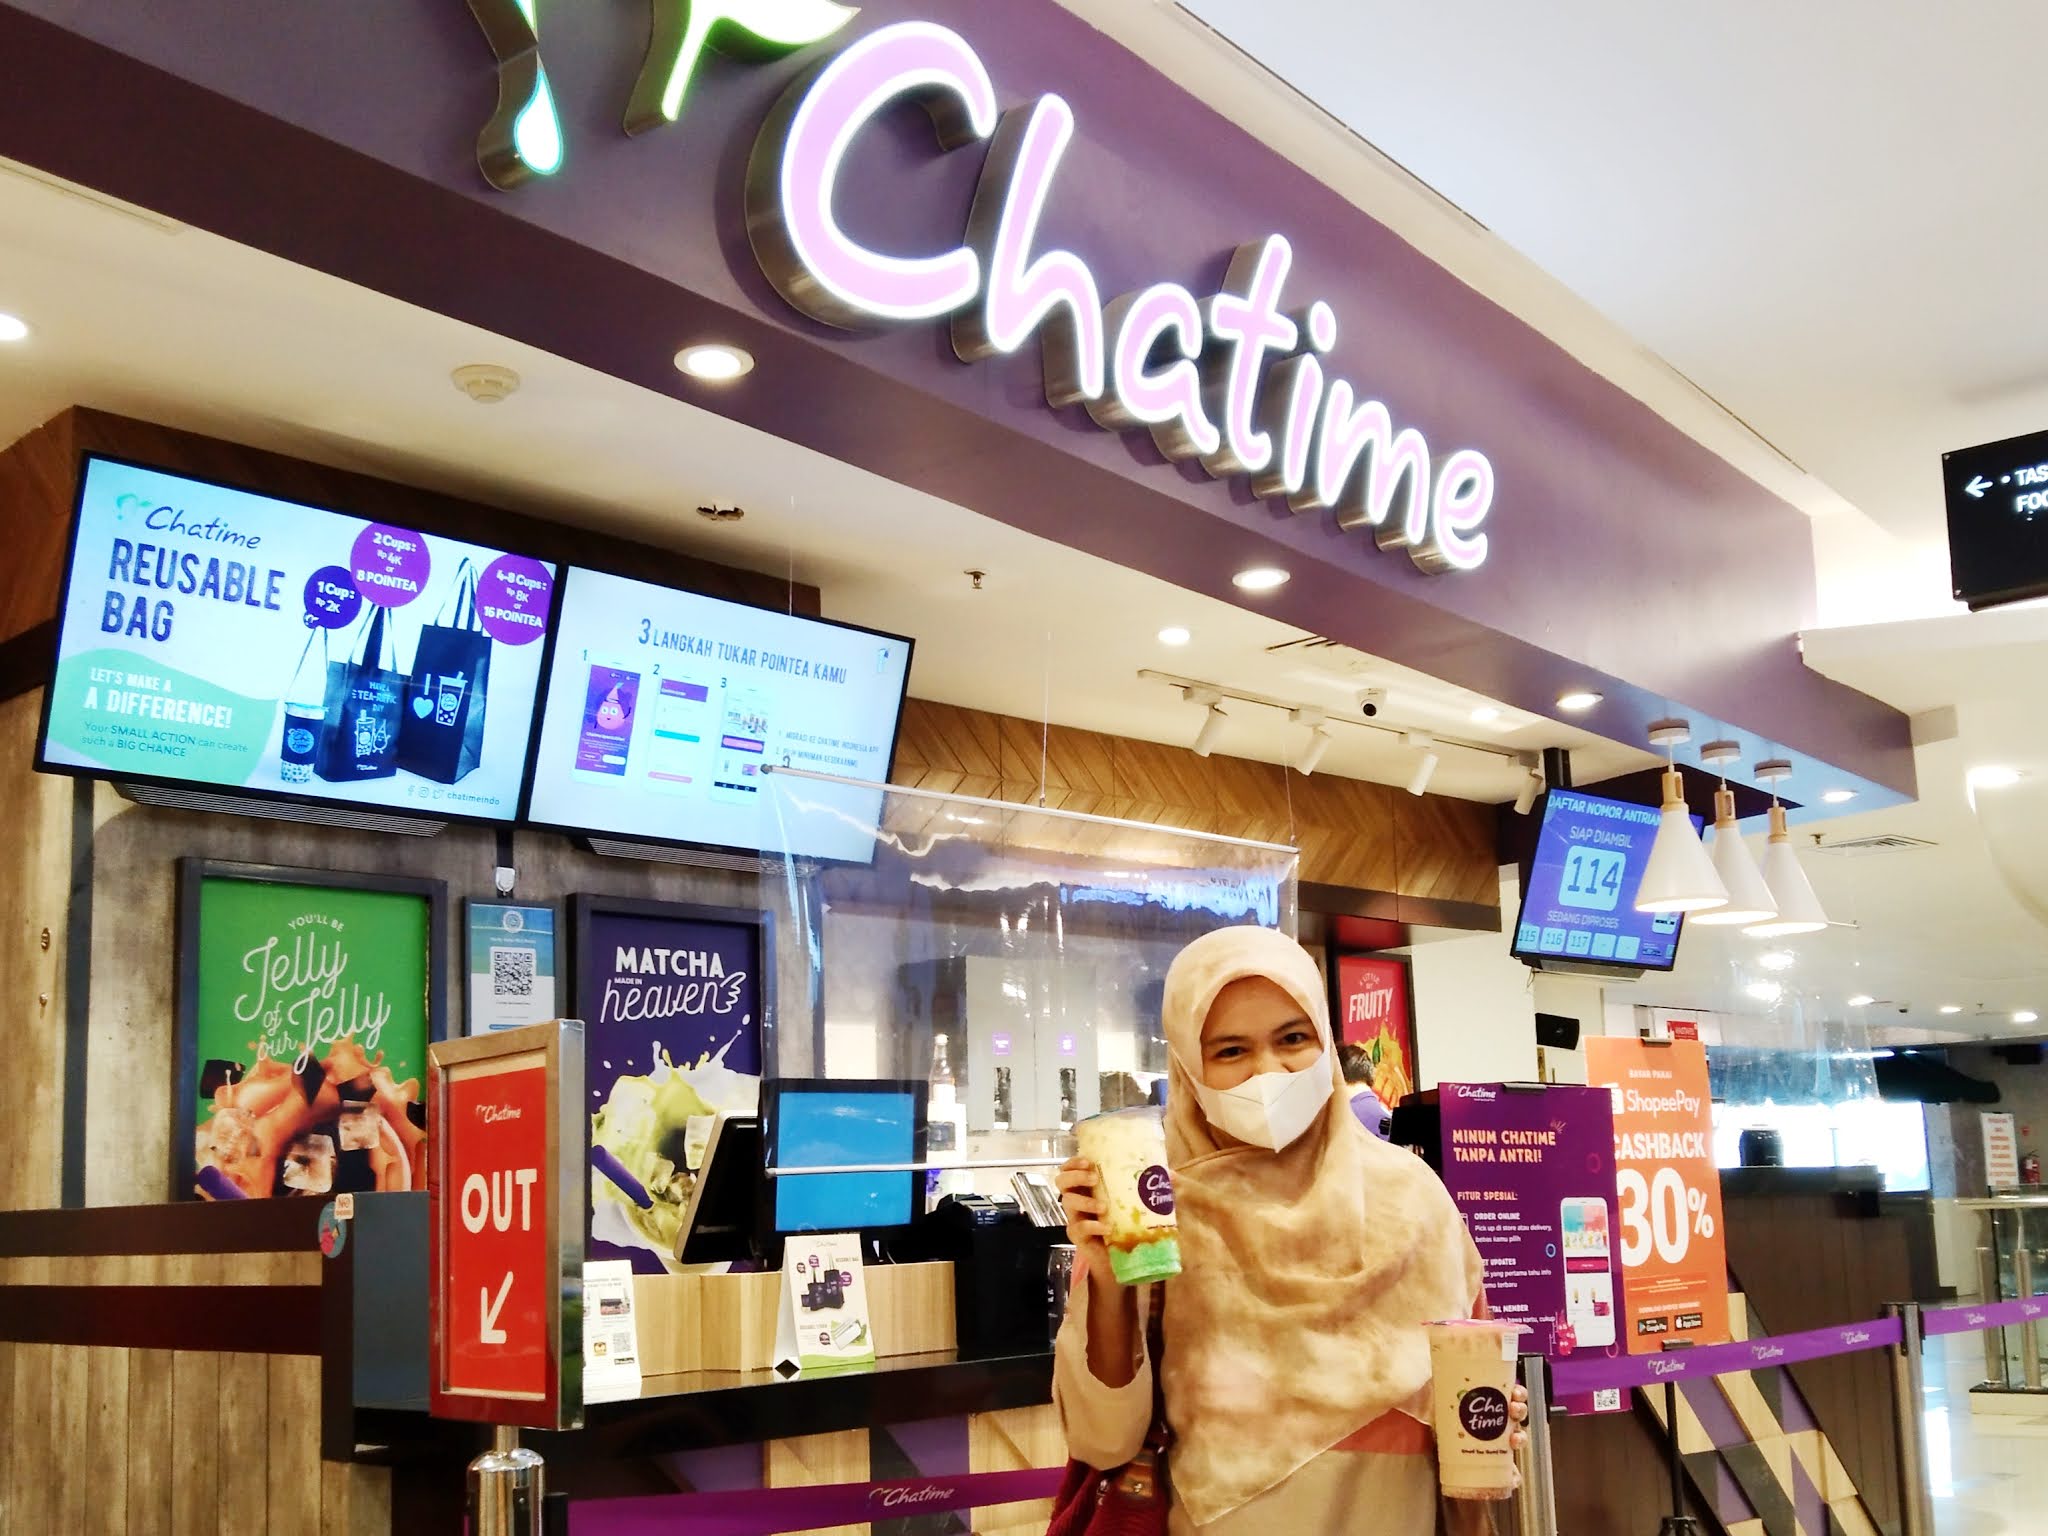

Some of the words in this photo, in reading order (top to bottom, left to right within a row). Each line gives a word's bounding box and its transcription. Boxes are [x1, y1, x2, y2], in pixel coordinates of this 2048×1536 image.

[780, 21, 1495, 571] Chatime
[145, 506, 261, 549] Chatime
[373, 532, 382, 545] 2
[382, 534, 416, 552] Cups:
[109, 537, 286, 611] REUSABLE
[356, 569, 366, 582] 8
[367, 571, 418, 592] POINTEA
[318, 581, 324, 593] 1
[101, 590, 174, 641] BAG
[496, 608, 543, 628] POINTEA
[583, 649, 588, 661] 1
[638, 618, 651, 644] 3
[653, 629, 713, 658] LANGKAH
[718, 642, 757, 666] TUKAR
[760, 652, 809, 677] POINTEA
[814, 663, 848, 684] KAMU
[90, 667, 123, 685] LET'S
[127, 673, 160, 691] MAKE
[163, 679, 173, 693] A
[652, 663, 660, 676] 2
[720, 677, 727, 689] 3
[83, 686, 98, 710] A
[106, 689, 233, 728] DIFFERENCE!
[84, 721, 109, 733] Your
[111, 725, 148, 739] SMALL
[152, 730, 196, 745] ACTION
[199, 739, 215, 748] can
[81, 736, 106, 746] such
[117, 740, 136, 751] BIG
[138, 742, 187, 757] CHANCE
[447, 791, 500, 806] chatimeindo
[1548, 795, 1586, 813] DAFTAR
[1586, 802, 1622, 819] NOMOR
[1569, 825, 1594, 842] SIAP
[1593, 830, 1633, 849] DIAMBIL
[1567, 855, 1620, 897] 114
[288, 914, 328, 930] YOU'LL
[331, 919, 345, 932] BE
[1547, 910, 1581, 925] SEDANG
[615, 946, 725, 978] MATCHA
[234, 931, 348, 1022] Jelly
[614, 977, 634, 985] MADE
[600, 979, 731, 1023] heaven
[263, 1000, 283, 1036] of
[288, 983, 391, 1075] Jelly
[257, 1031, 298, 1061] our
[1458, 1086, 1496, 1098] Chatime
[484, 1104, 521, 1123] Chatime
[1626, 1089, 1700, 1118] ShopeePay
[1452, 1129, 1497, 1144] MINUM
[1501, 1131, 1556, 1146] CHATIME
[1453, 1147, 1496, 1162] TANPA
[1499, 1148, 1542, 1163] ANTRI!
[461, 1168, 537, 1234] OUT
[1457, 1191, 1481, 1200] FITUR
[1483, 1191, 1518, 1200] SPESIAL:
[1474, 1212, 1496, 1220] ORDER
[1497, 1212, 1520, 1220] ONLINE
[1616, 1167, 1714, 1267] 30%
[1490, 1258, 1516, 1266] UPDATES
[1757, 1345, 1784, 1360] Chatime
[1655, 1358, 1686, 1375] Chatime
[1468, 1396, 1504, 1413] Cha
[1468, 1414, 1504, 1431] time
[883, 1484, 955, 1506] Chatime
